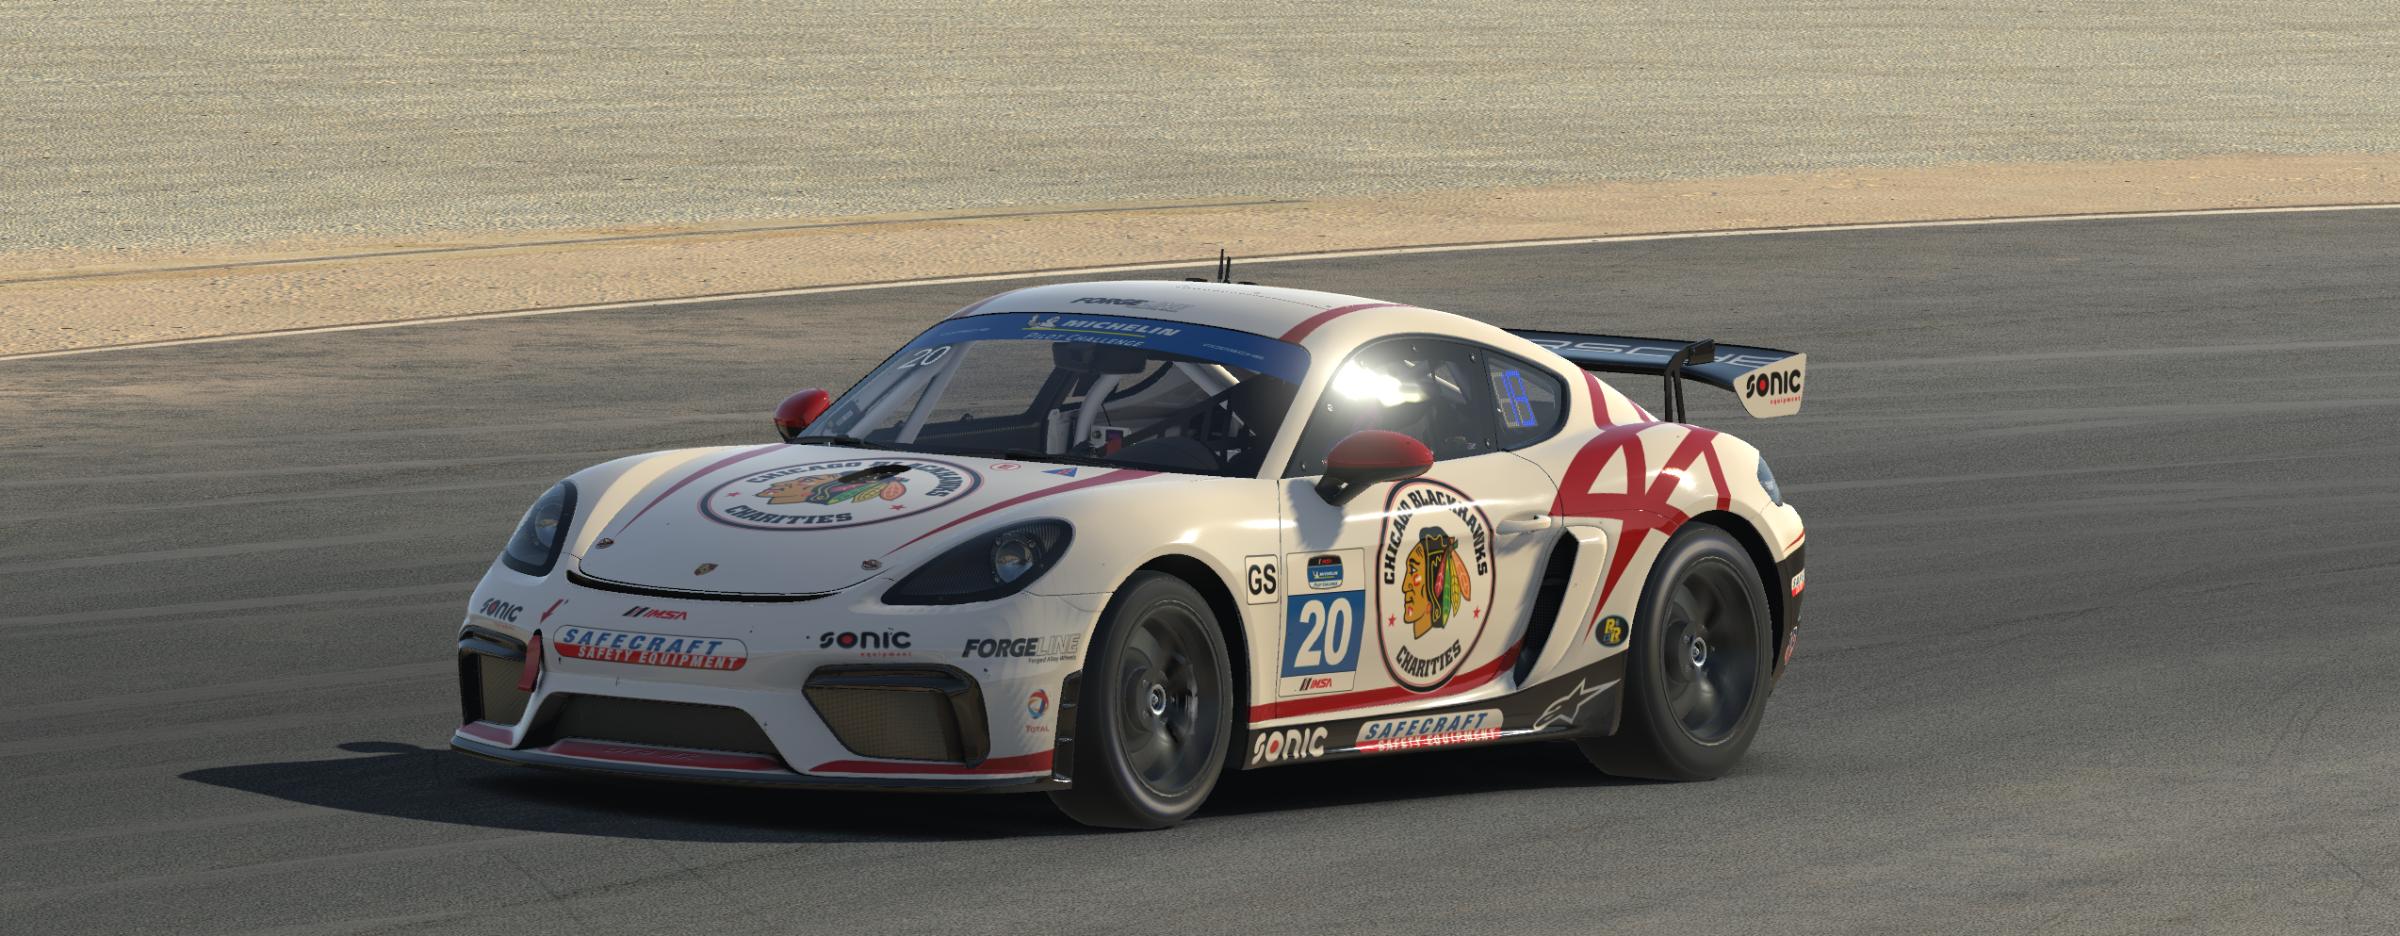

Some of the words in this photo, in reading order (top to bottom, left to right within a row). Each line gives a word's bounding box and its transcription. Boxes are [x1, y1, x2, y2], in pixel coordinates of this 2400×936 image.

[1062, 319, 1182, 337] MICHELIN
[897, 345, 951, 370] 20
[746, 461, 863, 483] CHICAGO
[724, 504, 853, 525] CHARITIES
[1248, 563, 1277, 596] GS
[643, 608, 688, 621] IMSA
[563, 628, 723, 655] SAFECRAFT
[1294, 597, 1353, 668] 20
[577, 646, 635, 662] SAFETY
[639, 652, 740, 670] EQUIPMENT
[1395, 638, 1463, 678] CHARITIES
[1310, 678, 1332, 689] IMSA
[1025, 725, 1050, 733] TOTAL
[1365, 713, 1488, 740] SAFECRAFT
